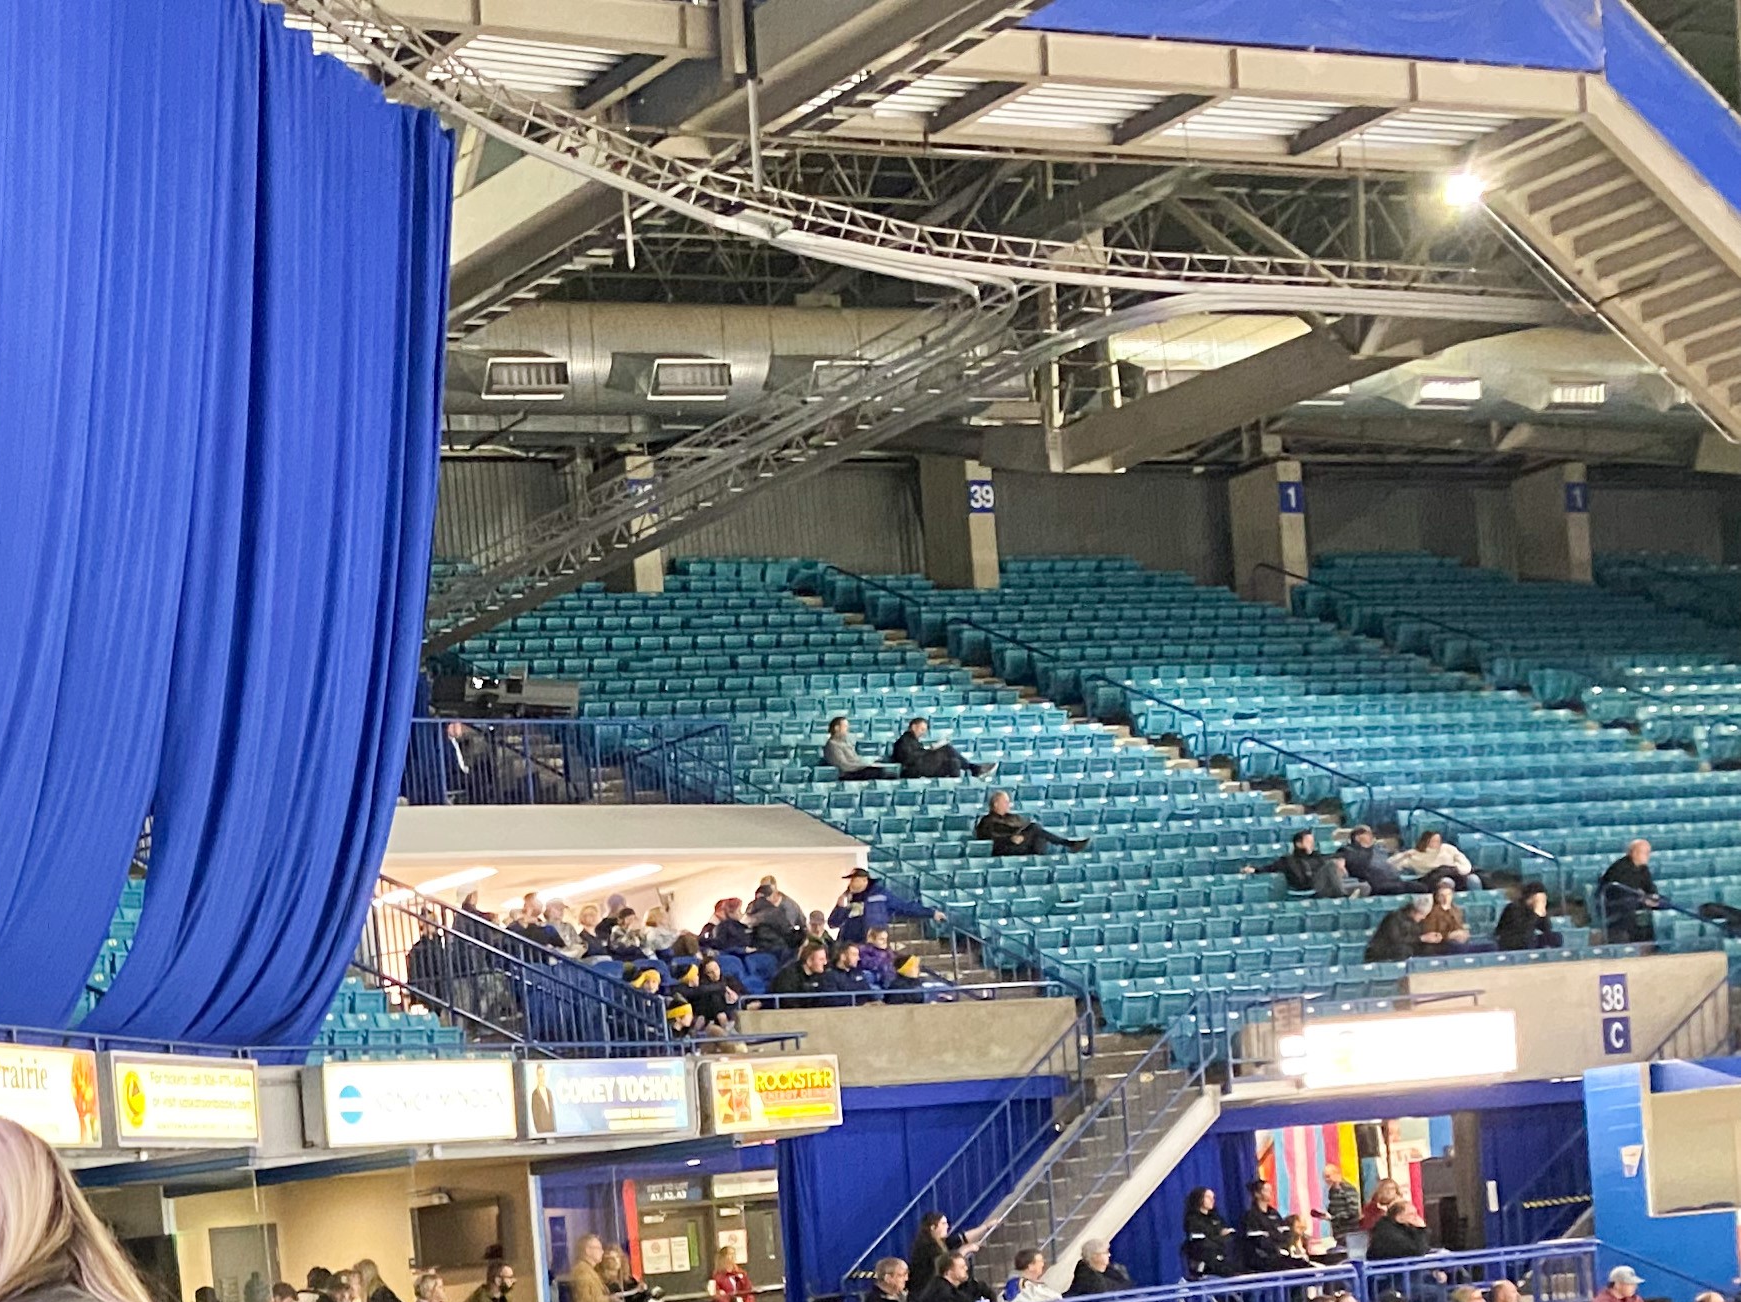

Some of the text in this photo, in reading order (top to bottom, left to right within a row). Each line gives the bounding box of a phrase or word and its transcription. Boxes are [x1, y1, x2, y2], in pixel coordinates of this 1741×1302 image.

[970, 485, 995, 508] 39
[1287, 486, 1296, 508] 1
[1602, 984, 1625, 1011] 38
[1610, 1021, 1624, 1049] C
[557, 1075, 686, 1104] COREY TOCHOR
